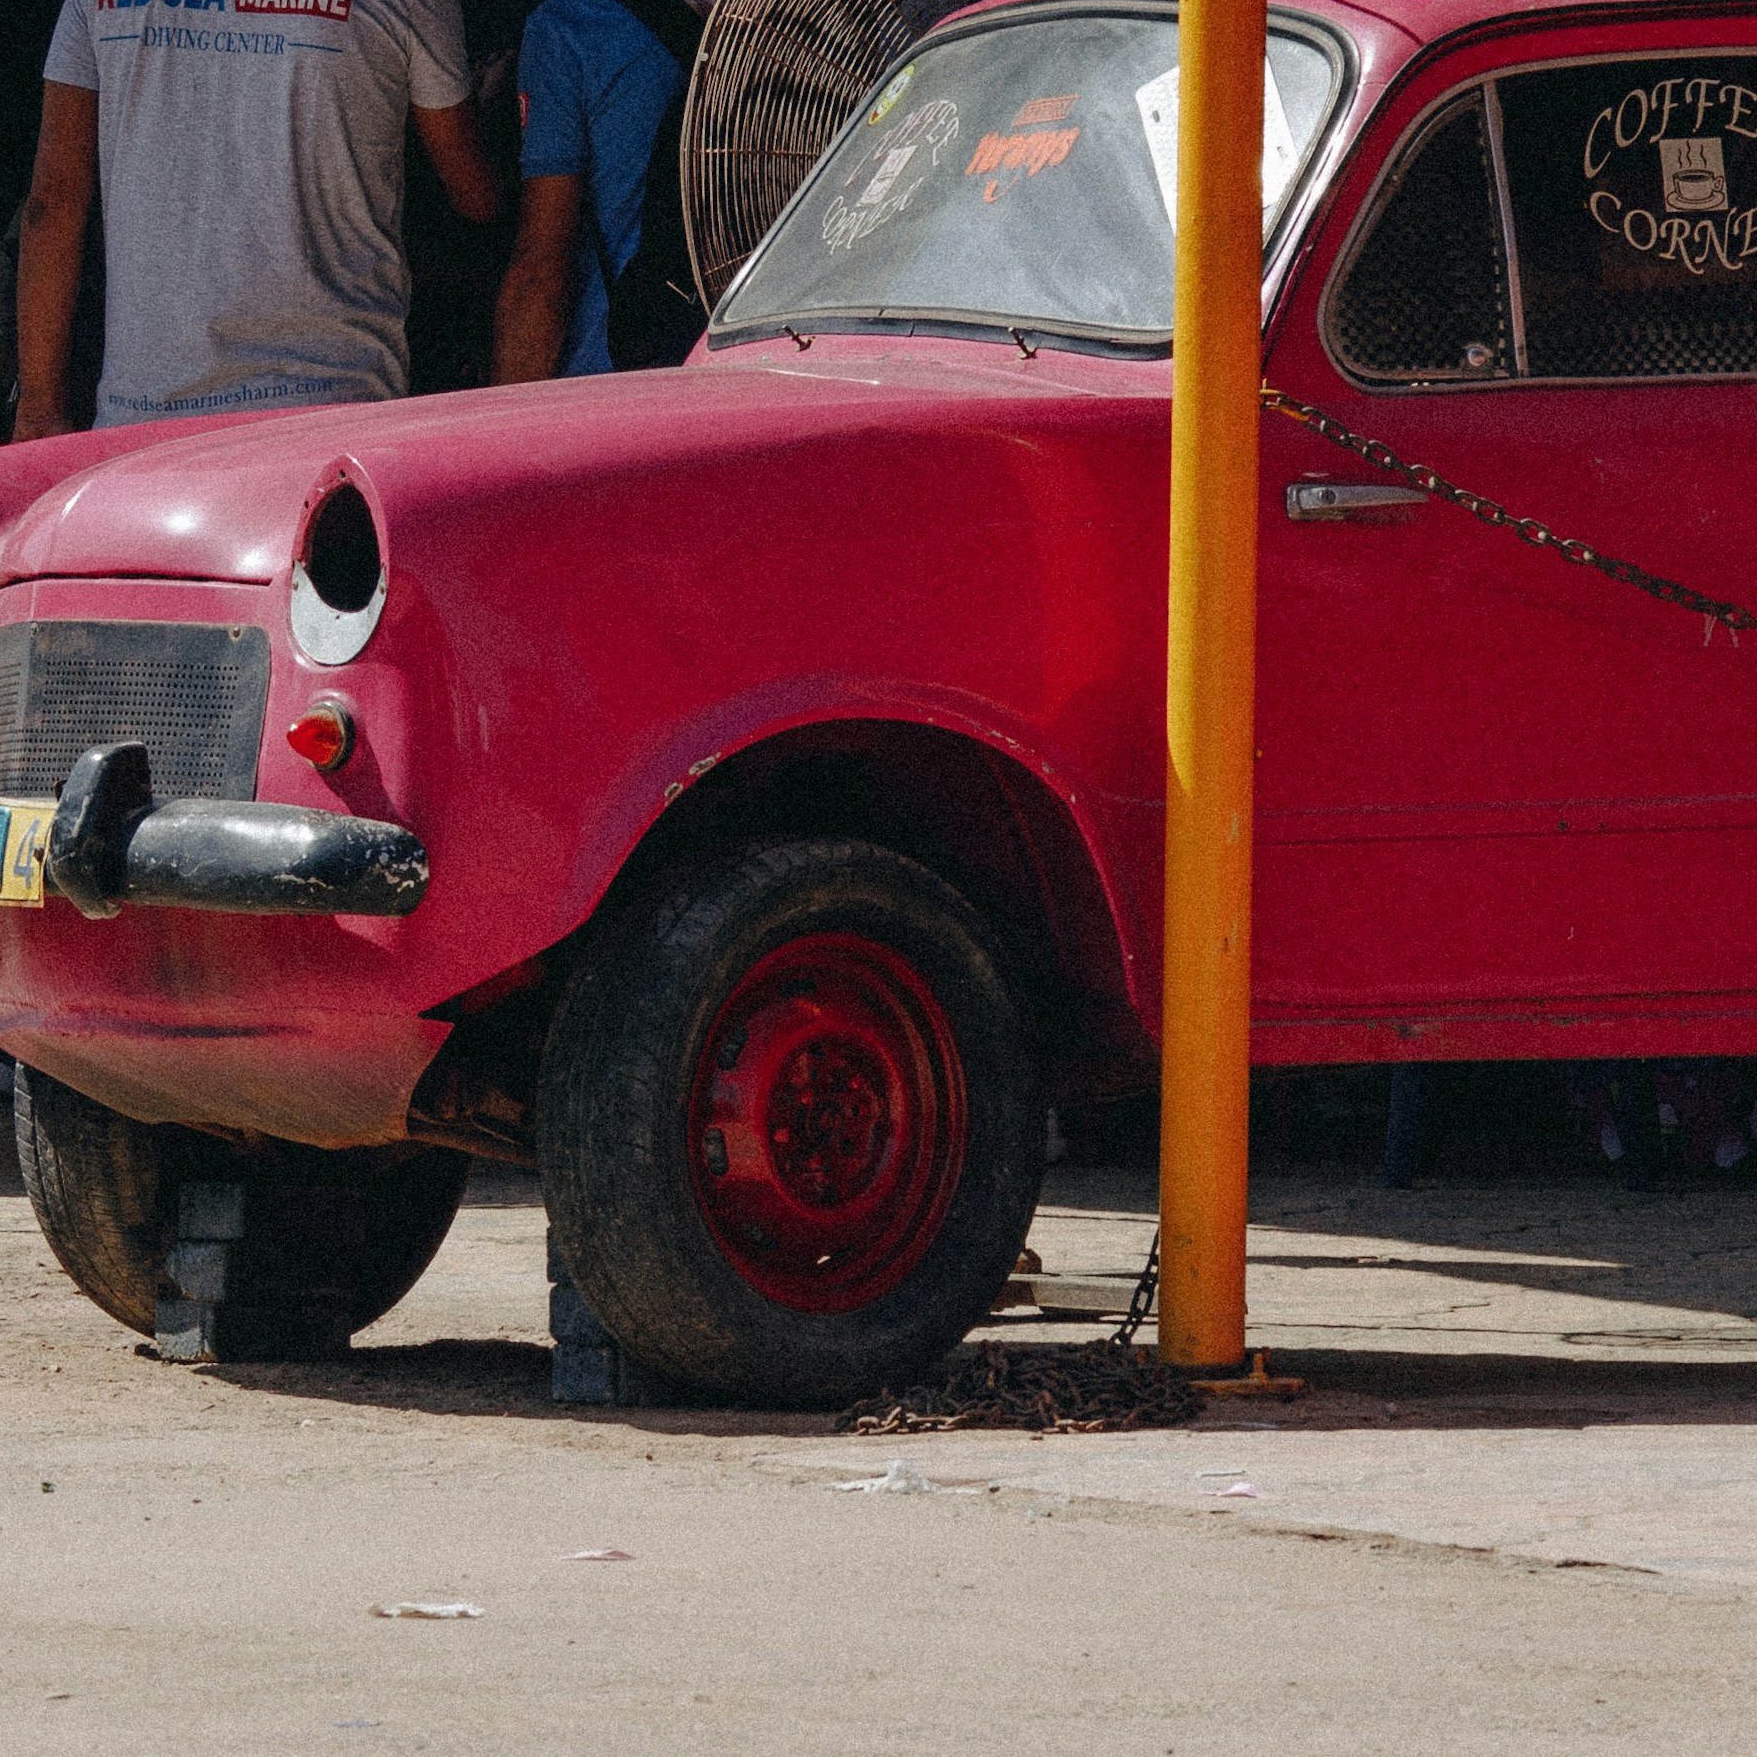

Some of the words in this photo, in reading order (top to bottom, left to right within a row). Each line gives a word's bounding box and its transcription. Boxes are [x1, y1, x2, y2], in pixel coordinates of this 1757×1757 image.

[143, 26, 210, 51] DIVING
[214, 31, 285, 56] CENTER
[13, 817, 41, 889] 4
